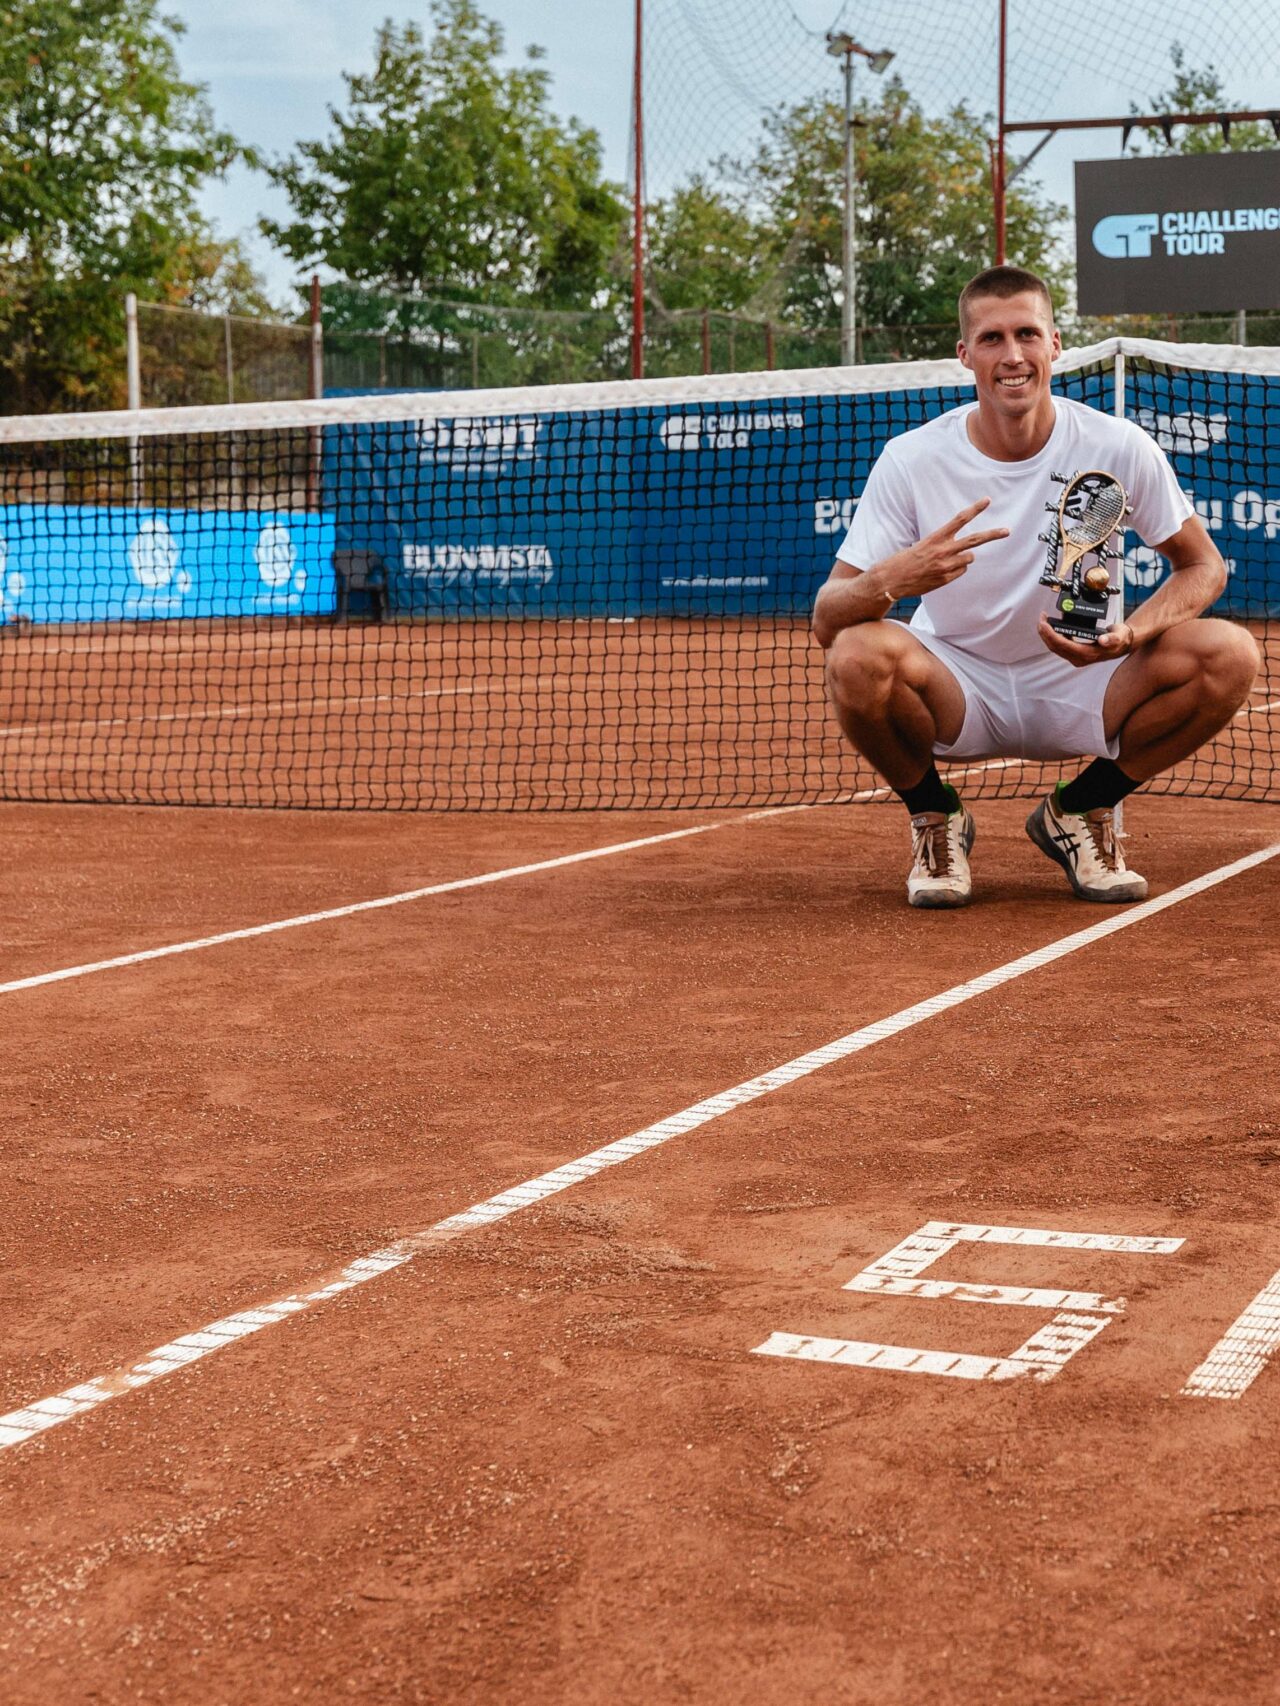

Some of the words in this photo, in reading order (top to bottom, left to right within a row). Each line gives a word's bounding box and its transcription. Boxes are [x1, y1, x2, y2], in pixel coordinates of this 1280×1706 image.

[1162, 232, 1226, 257] TOUR
[1054, 626, 1077, 636] WINNER
[1077, 631, 1099, 640] SINGLE
